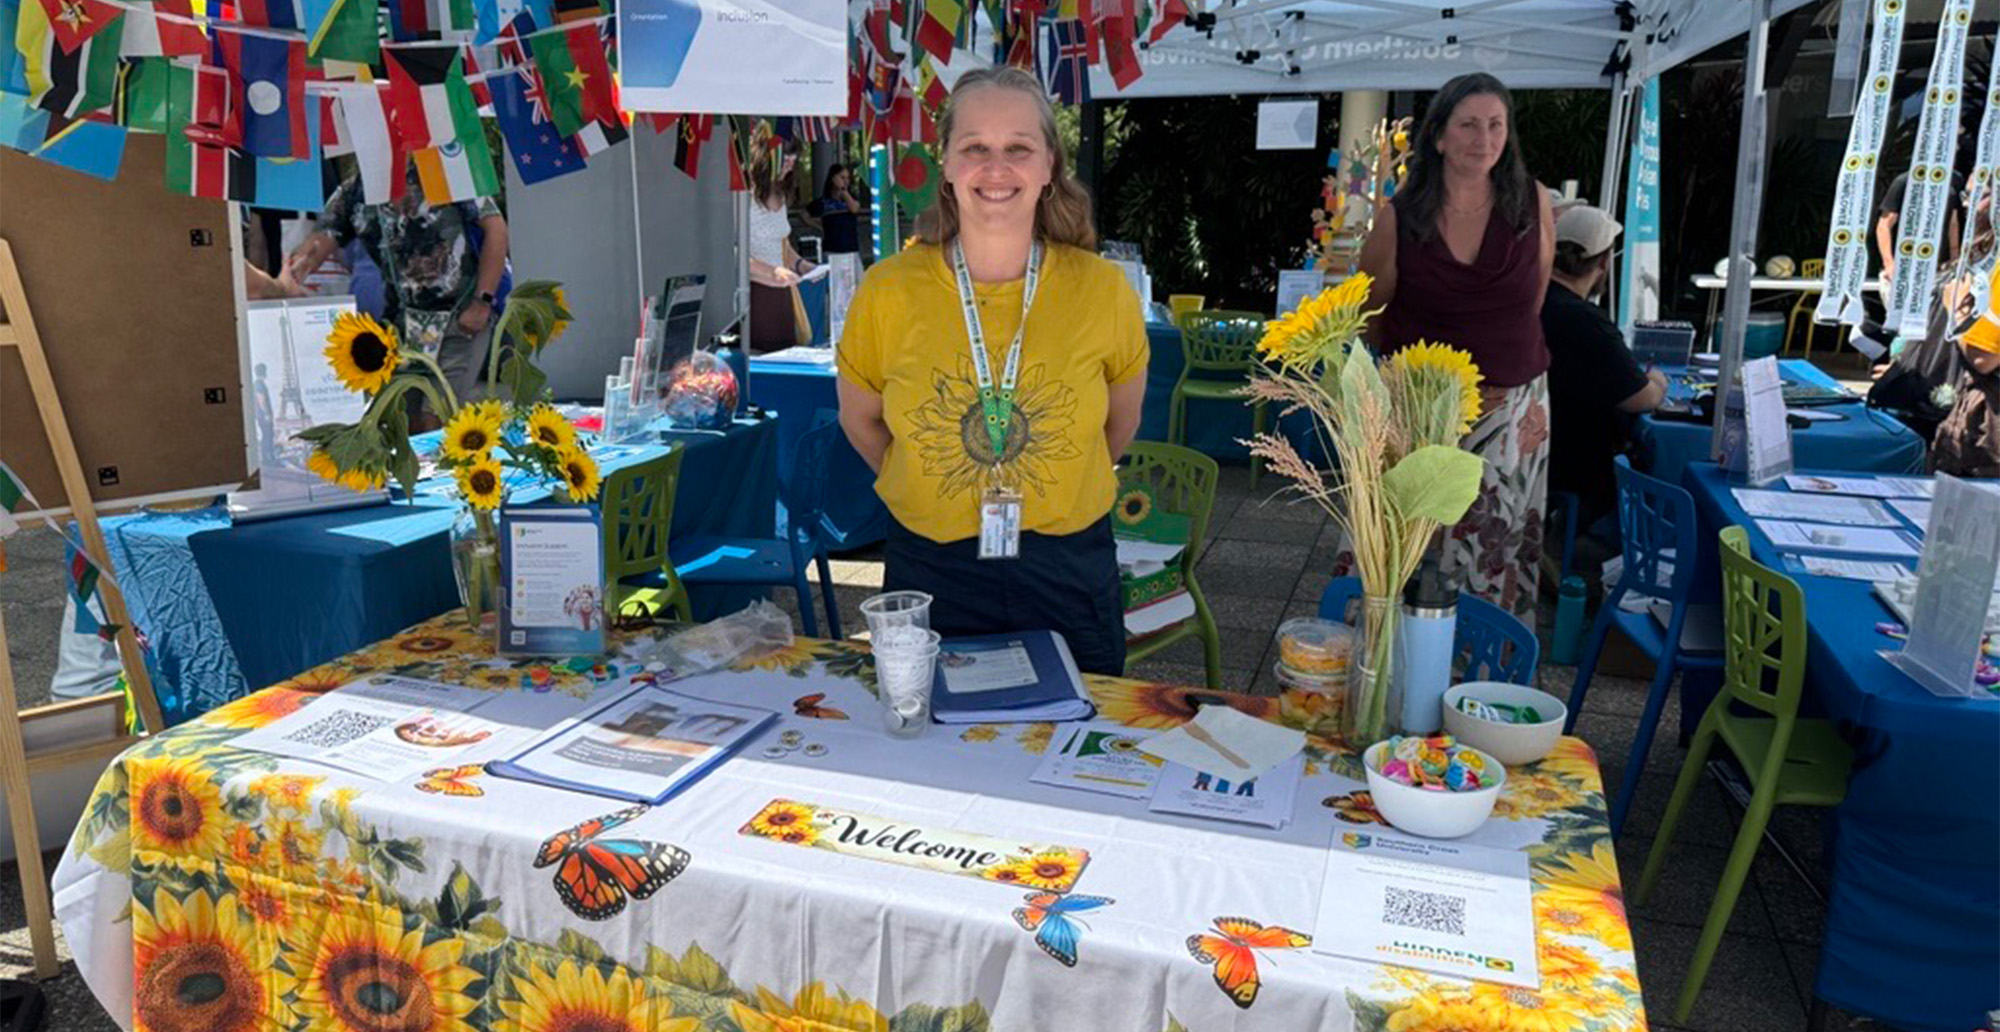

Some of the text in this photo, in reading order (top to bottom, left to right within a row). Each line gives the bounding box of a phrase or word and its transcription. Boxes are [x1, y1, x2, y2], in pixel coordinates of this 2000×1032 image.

[717, 9, 768, 22] Inclusion
[1838, 173, 1850, 226] SUNFLOWER
[1905, 184, 1920, 236] SUNFLOWER
[1923, 185, 1938, 239] SUNFLOWER
[1828, 247, 1842, 298] SUNFLOWER
[1895, 258, 1909, 310] SUNFLOWER
[1909, 260, 1925, 314] SUNFLOWER
[832, 815, 1000, 869] Welcome
[1393, 940, 1483, 963] HIDDEN
